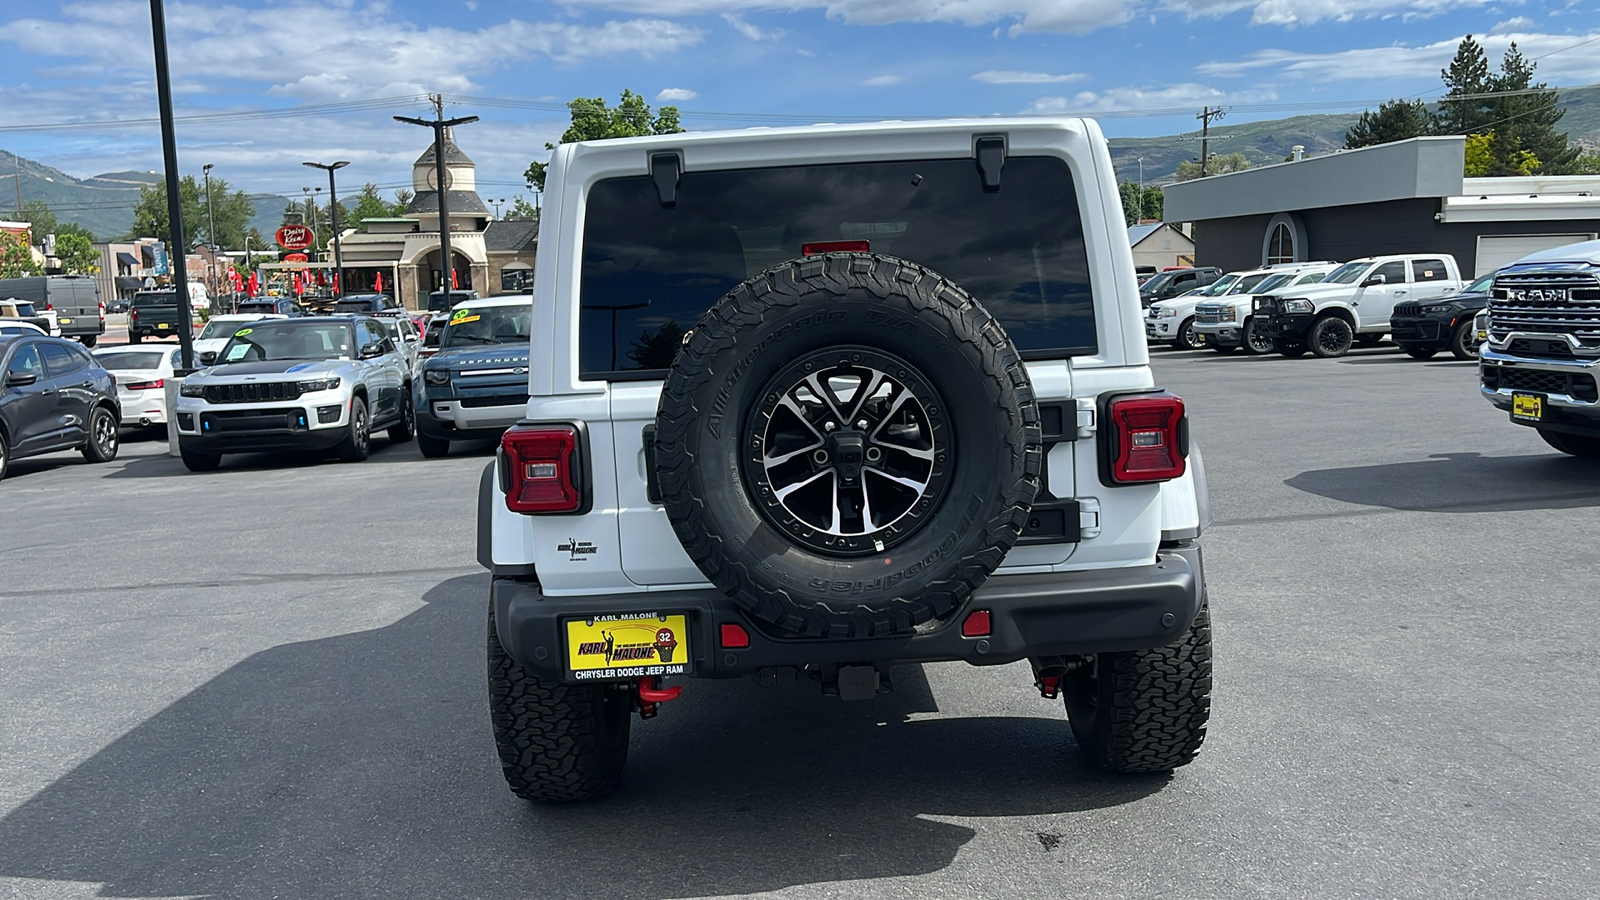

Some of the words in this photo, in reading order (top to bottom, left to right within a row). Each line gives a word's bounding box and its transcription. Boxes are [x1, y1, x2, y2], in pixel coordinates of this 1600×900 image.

[1509, 289, 1566, 301] RAM
[460, 357, 528, 365] DEFENDER
[621, 612, 657, 620] MALONE
[659, 632, 671, 642] 32
[578, 642, 606, 655] KARL
[612, 646, 655, 661] MALONE
[575, 669, 616, 680] CHRYSLER
[617, 667, 644, 677] DODGE
[645, 666, 665, 675] JEEP
[666, 665, 684, 674] RAM
